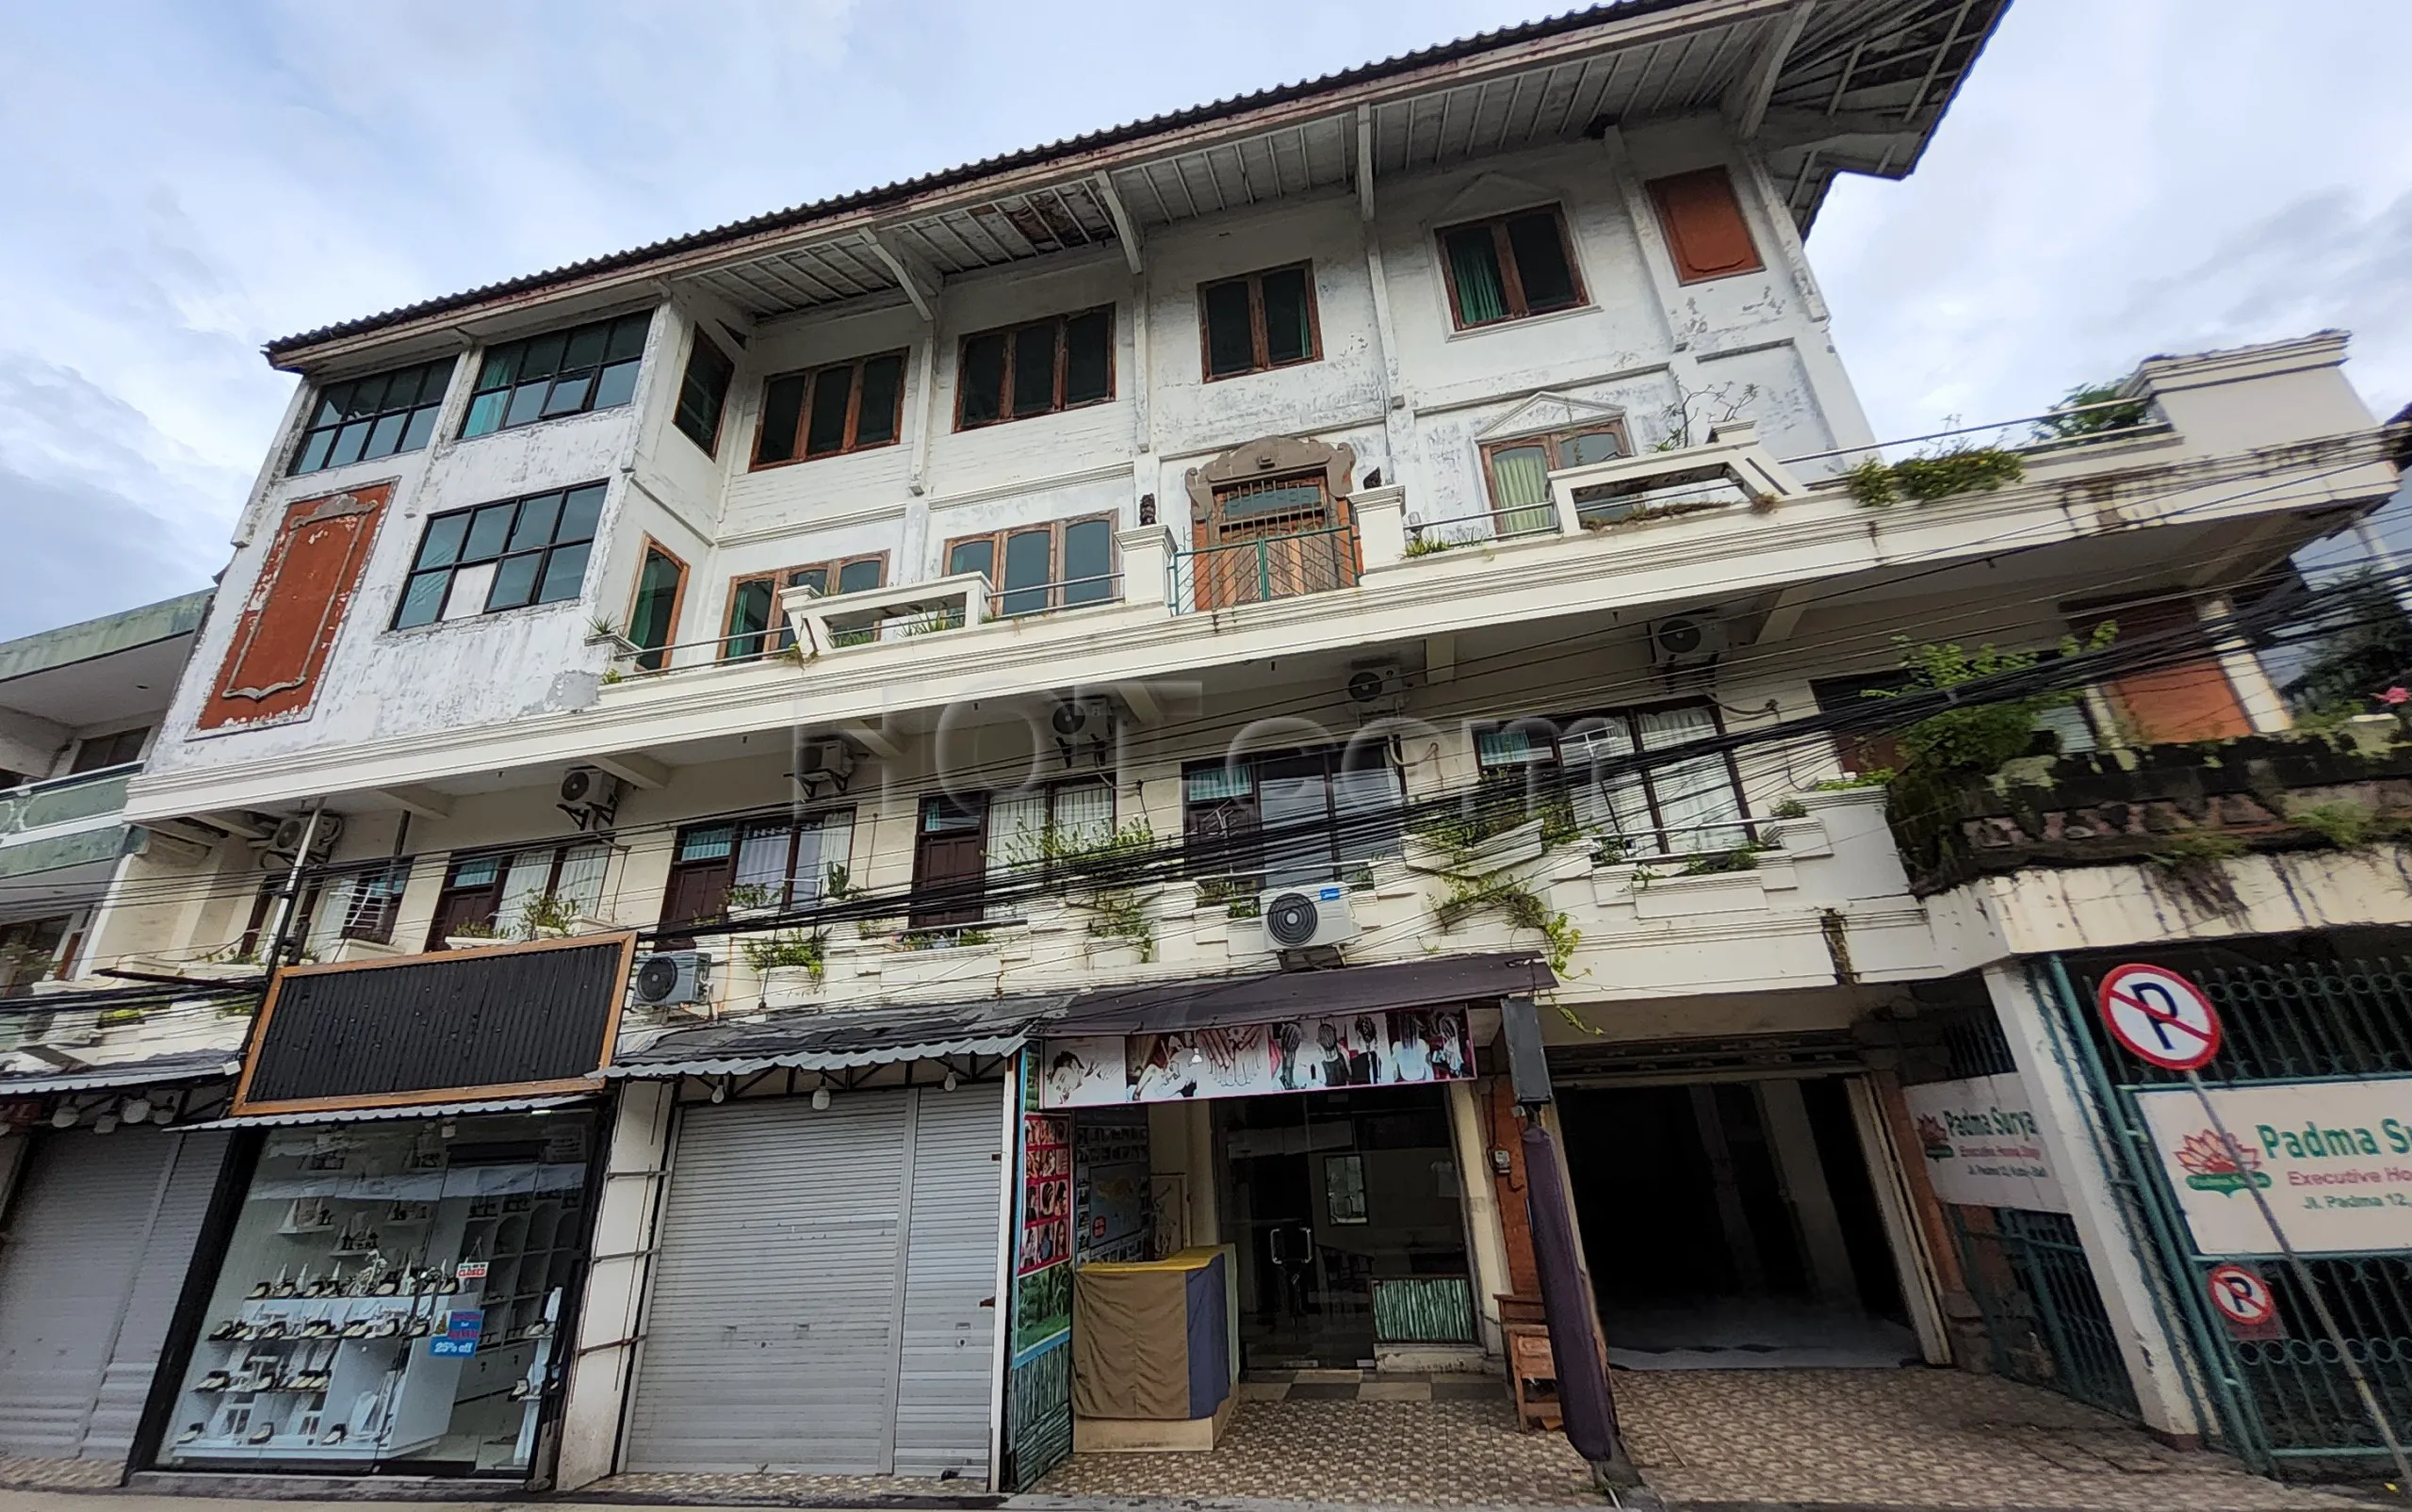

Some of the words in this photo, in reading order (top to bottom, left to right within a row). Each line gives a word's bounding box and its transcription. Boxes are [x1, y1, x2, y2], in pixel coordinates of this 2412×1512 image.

[2128, 983, 2178, 1050] P
[2255, 1120, 2382, 1160] Padma
[2287, 1169, 2382, 1186] Executive
[2323, 1195, 2385, 1209] Padma
[2223, 1276, 2253, 1313] P
